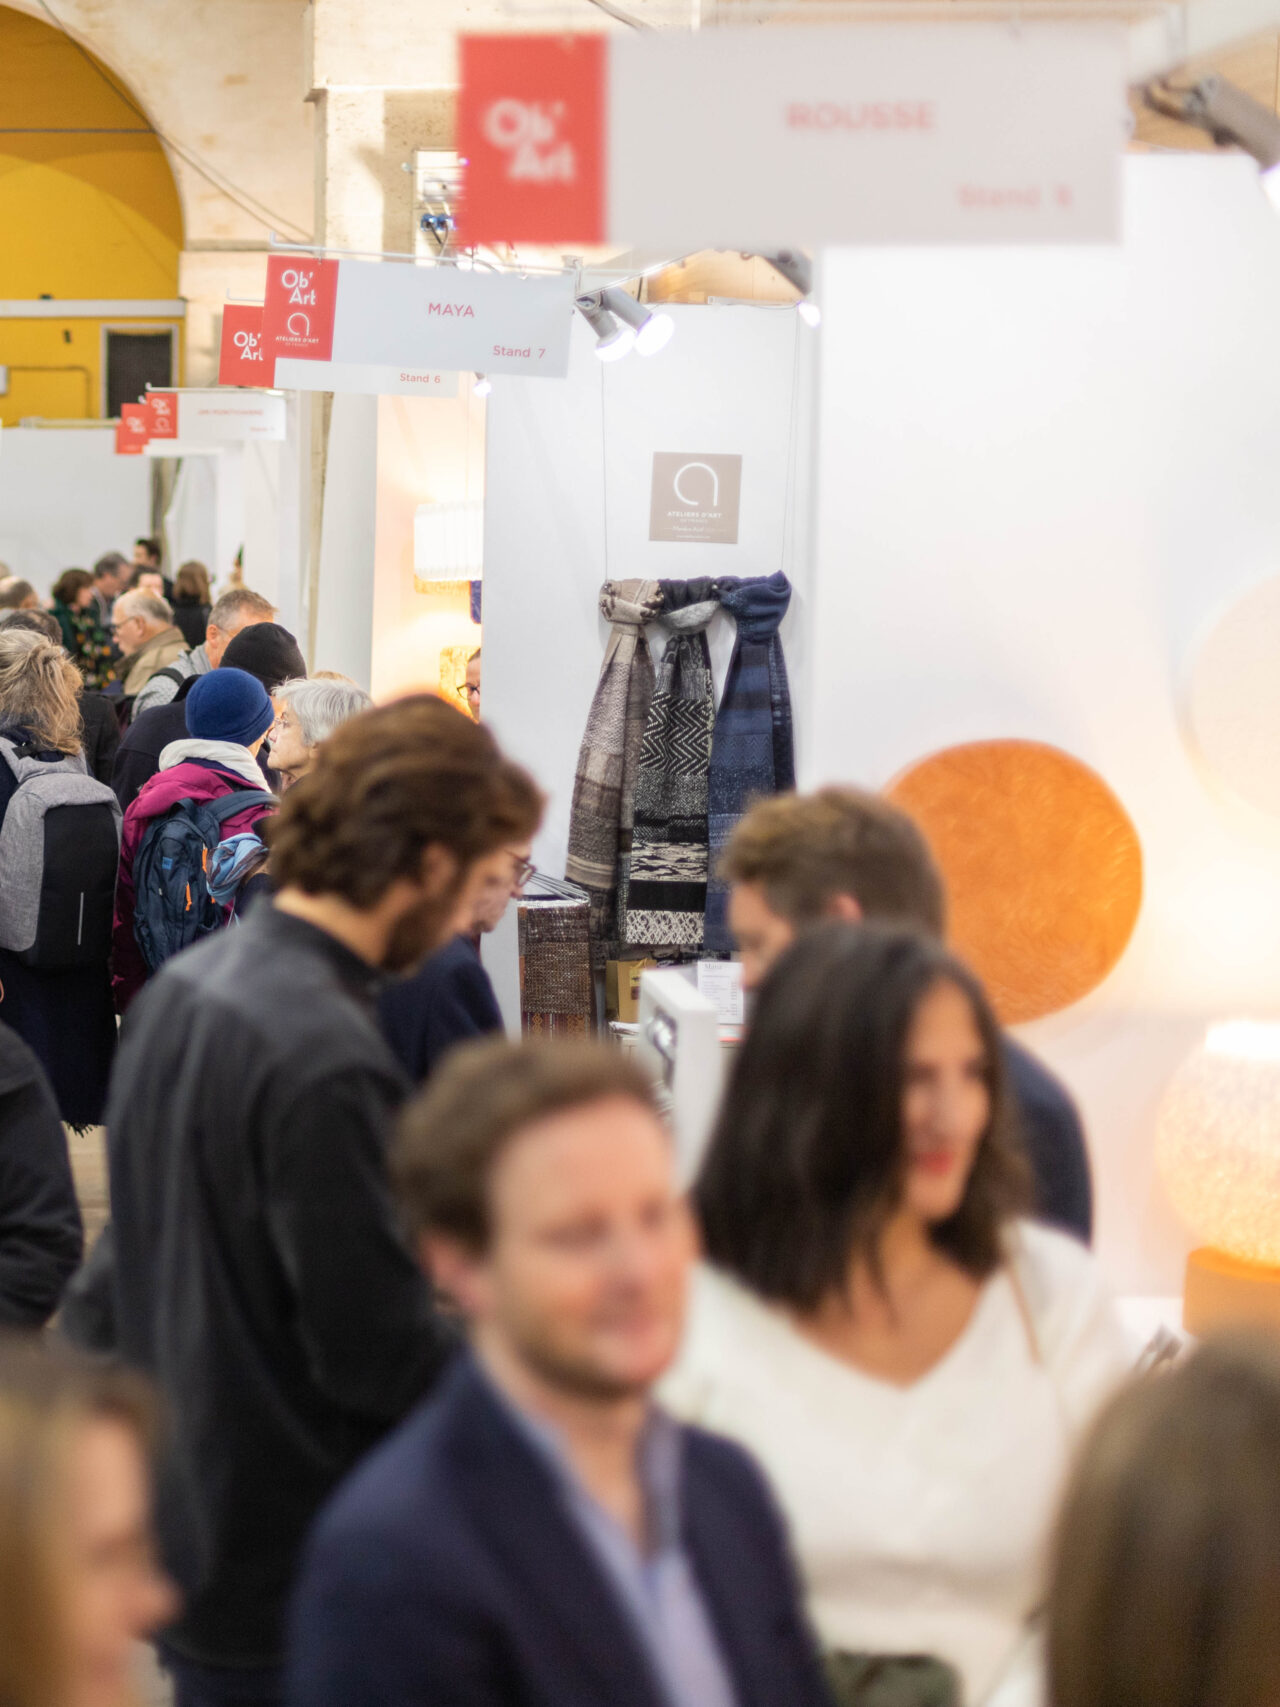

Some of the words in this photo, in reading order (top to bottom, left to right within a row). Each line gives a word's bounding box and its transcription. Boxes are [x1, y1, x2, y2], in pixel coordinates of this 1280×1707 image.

[786, 101, 934, 130] ROUSSE
[281, 269, 314, 288] Ob'
[288, 286, 316, 305] Art
[428, 302, 475, 318] MAYA
[233, 331, 262, 347] Ob'
[493, 345, 531, 358] Stand
[538, 348, 546, 359] 7
[400, 373, 430, 383] Stand
[434, 375, 441, 384] 6
